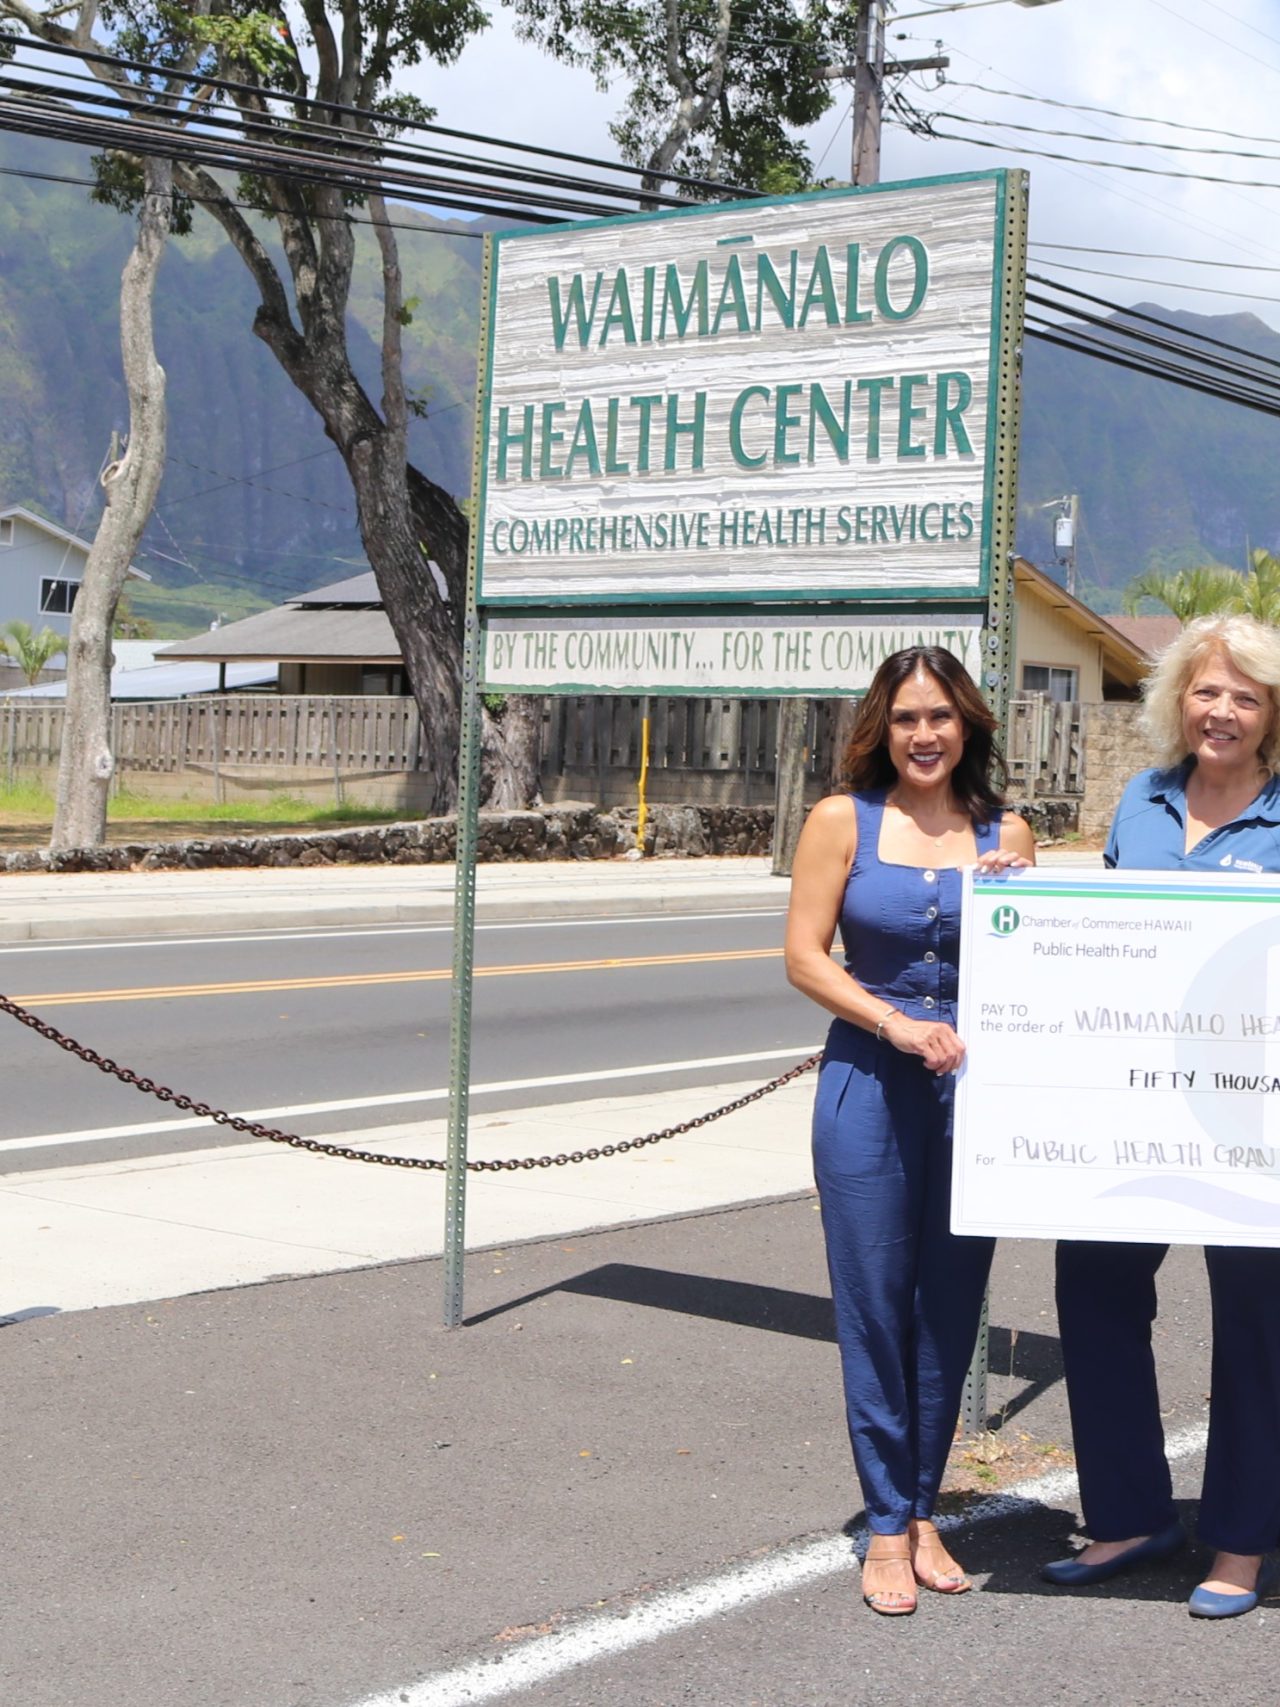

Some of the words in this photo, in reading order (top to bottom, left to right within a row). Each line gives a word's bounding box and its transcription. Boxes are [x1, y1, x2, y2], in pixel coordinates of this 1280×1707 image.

[547, 233, 930, 353] WAIMĀNALO
[496, 391, 707, 482] HEALTH
[728, 371, 976, 469] CENTER
[492, 511, 710, 554] COMPREHENSIVE
[719, 506, 826, 546] HEALTH
[836, 501, 975, 545] SERVICES
[493, 633, 517, 670] BY
[523, 632, 558, 670] THE
[722, 631, 764, 671] FOR
[773, 630, 813, 671] THE
[1021, 915, 1072, 929] Chamber
[1082, 917, 1142, 931] Commerce
[1144, 919, 1192, 932] HAWAII
[1033, 942, 1073, 957] Public
[1075, 943, 1120, 958] Health
[1122, 944, 1157, 959] Fund
[980, 1003, 1005, 1017] PAY
[1008, 1004, 1029, 1018] TO
[1074, 1006, 1226, 1036] WAIMANALO
[980, 1020, 1003, 1033] the
[1007, 1020, 1045, 1034] order
[1048, 1021, 1065, 1035] of
[1129, 1068, 1196, 1089] FIFTY
[975, 1154, 996, 1165] For
[1012, 1135, 1097, 1164] PUBLIC
[1113, 1139, 1202, 1167] HEALTH
